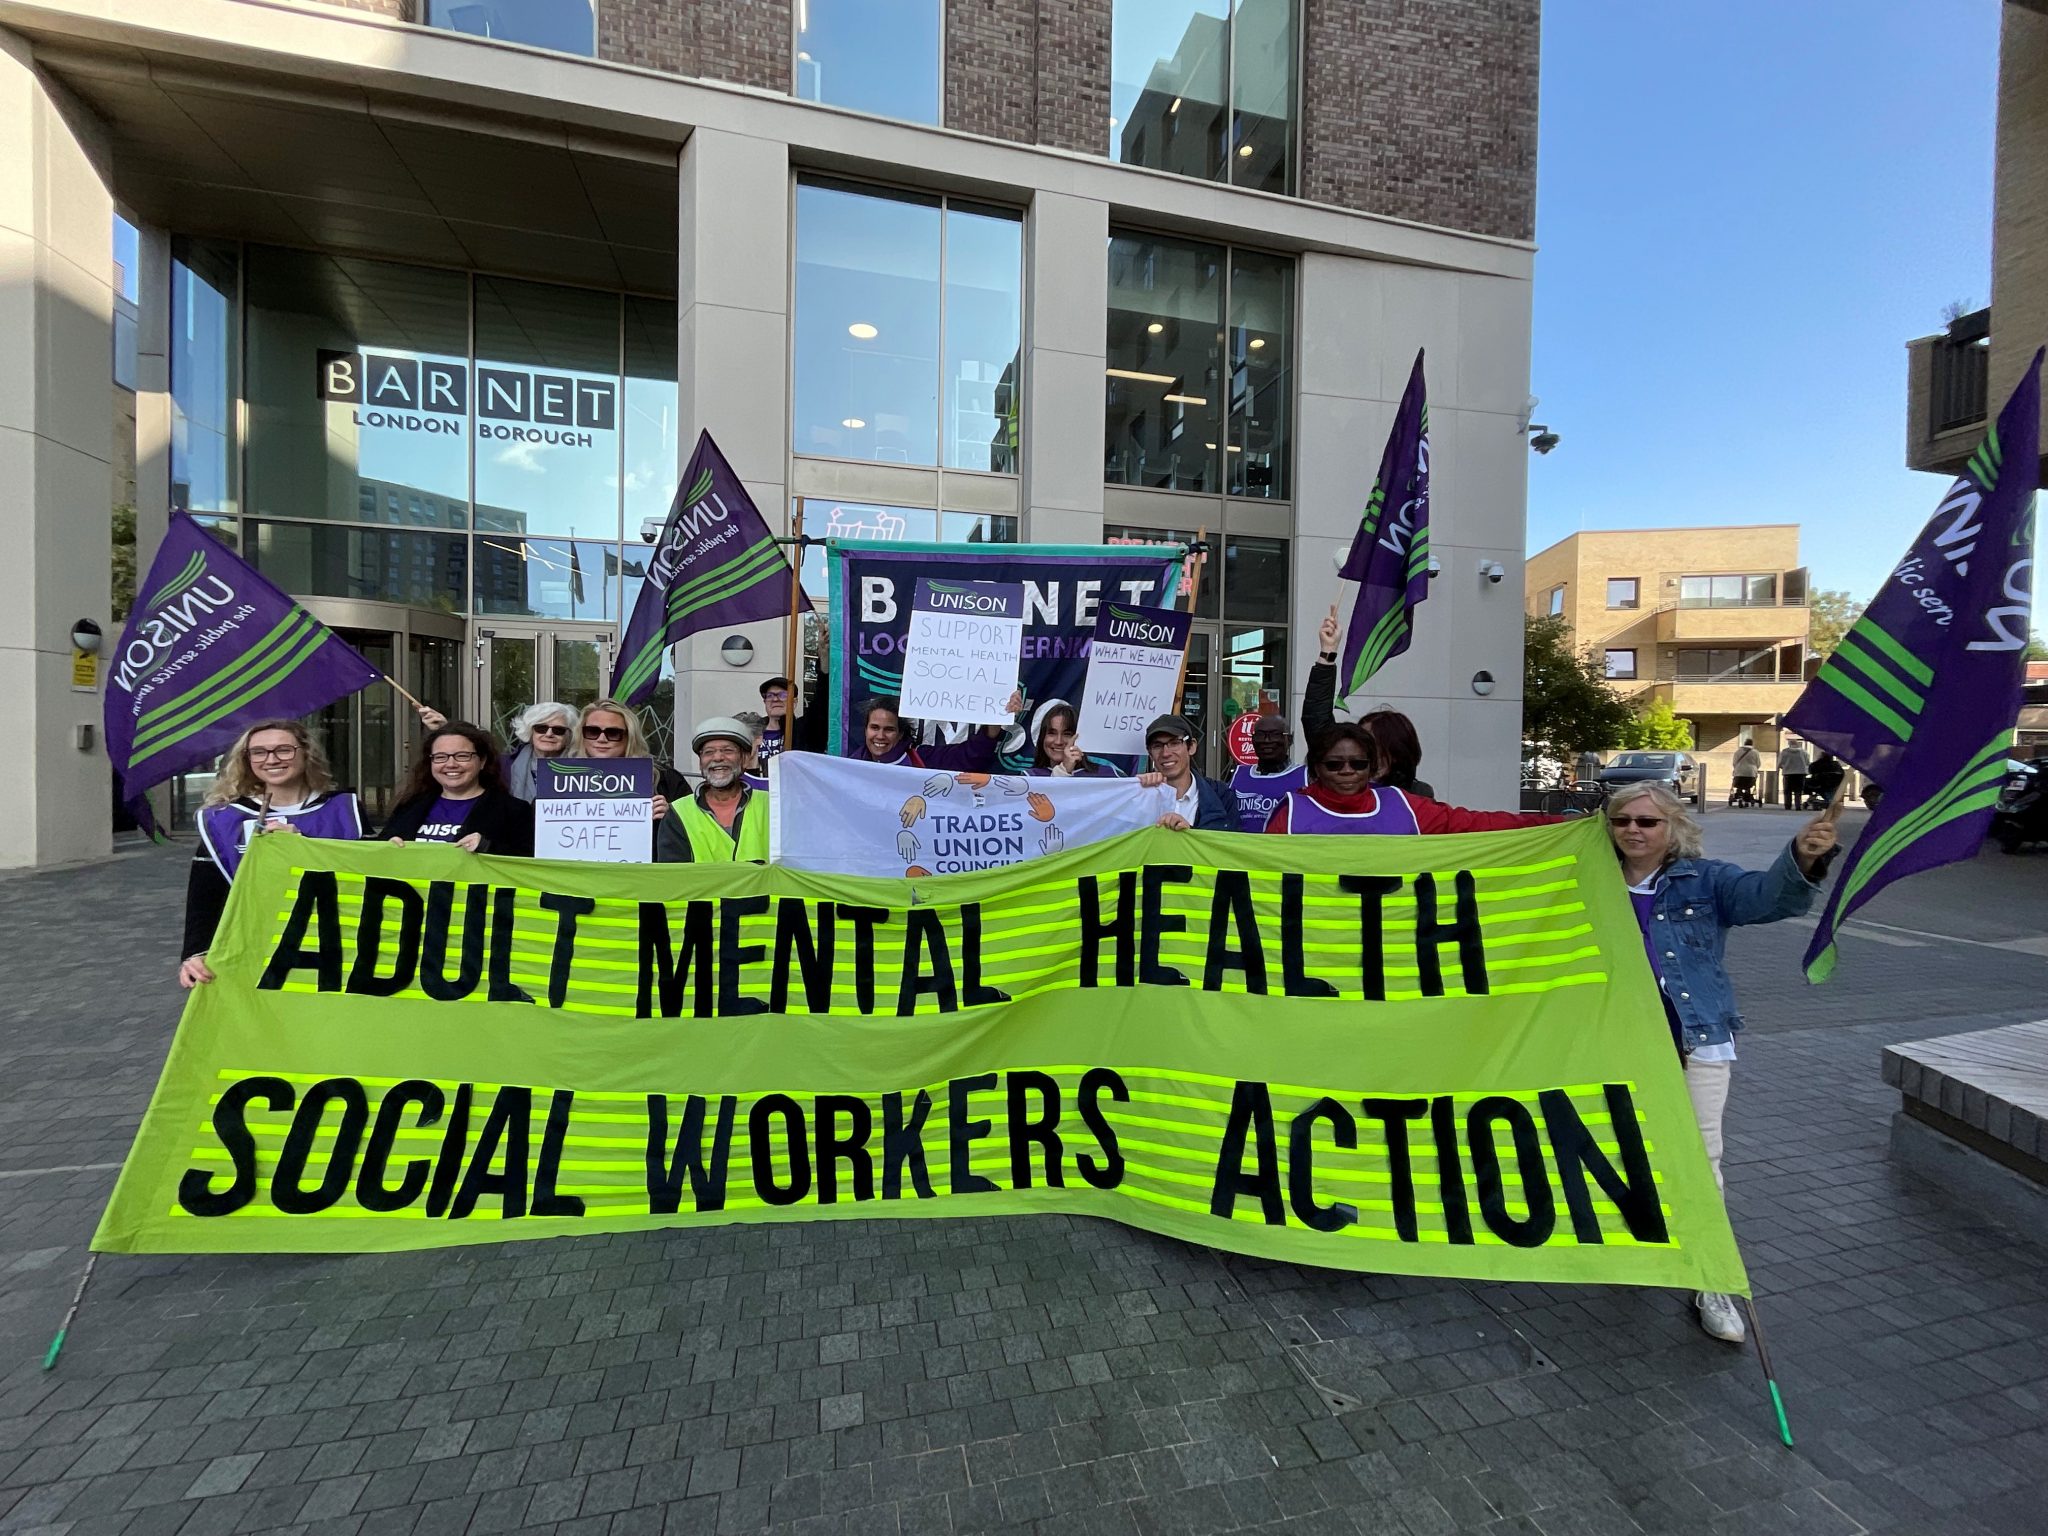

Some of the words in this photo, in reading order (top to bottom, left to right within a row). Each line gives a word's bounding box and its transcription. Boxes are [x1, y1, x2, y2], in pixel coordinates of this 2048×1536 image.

[327, 358, 611, 422] BARNET
[352, 410, 460, 435] LONDON
[479, 424, 592, 447] BOROUGH
[930, 592, 1007, 612] UNISON
[920, 617, 1018, 646] SUPPORT
[1109, 619, 1175, 643] UNISON
[911, 646, 965, 658] MENTAL
[971, 649, 1018, 662] HEALTH
[1095, 645, 1127, 660] WHAT
[1129, 649, 1145, 662] WE
[1149, 653, 1182, 667] WANT
[914, 660, 1008, 685] SOCIAL
[1120, 670, 1141, 688] NO
[909, 688, 1009, 716] WORKERS
[1095, 690, 1158, 713] WAITING
[1103, 714, 1144, 731] LISTS
[554, 775, 635, 793] UNISON
[542, 802, 581, 817] WHAT
[586, 802, 605, 817] WE
[613, 801, 652, 817] WANT
[931, 813, 1024, 833] TRADES
[558, 826, 622, 850] SAFE
[933, 836, 1024, 857] UNION
[256, 870, 595, 1009] ADULT
[636, 894, 1013, 1019] MENTAL
[1078, 865, 1490, 1001] HEALTH
[178, 1076, 586, 1219] SOCIAL
[646, 1067, 1131, 1214] WORKERS
[1210, 1080, 1670, 1248] ACTION
